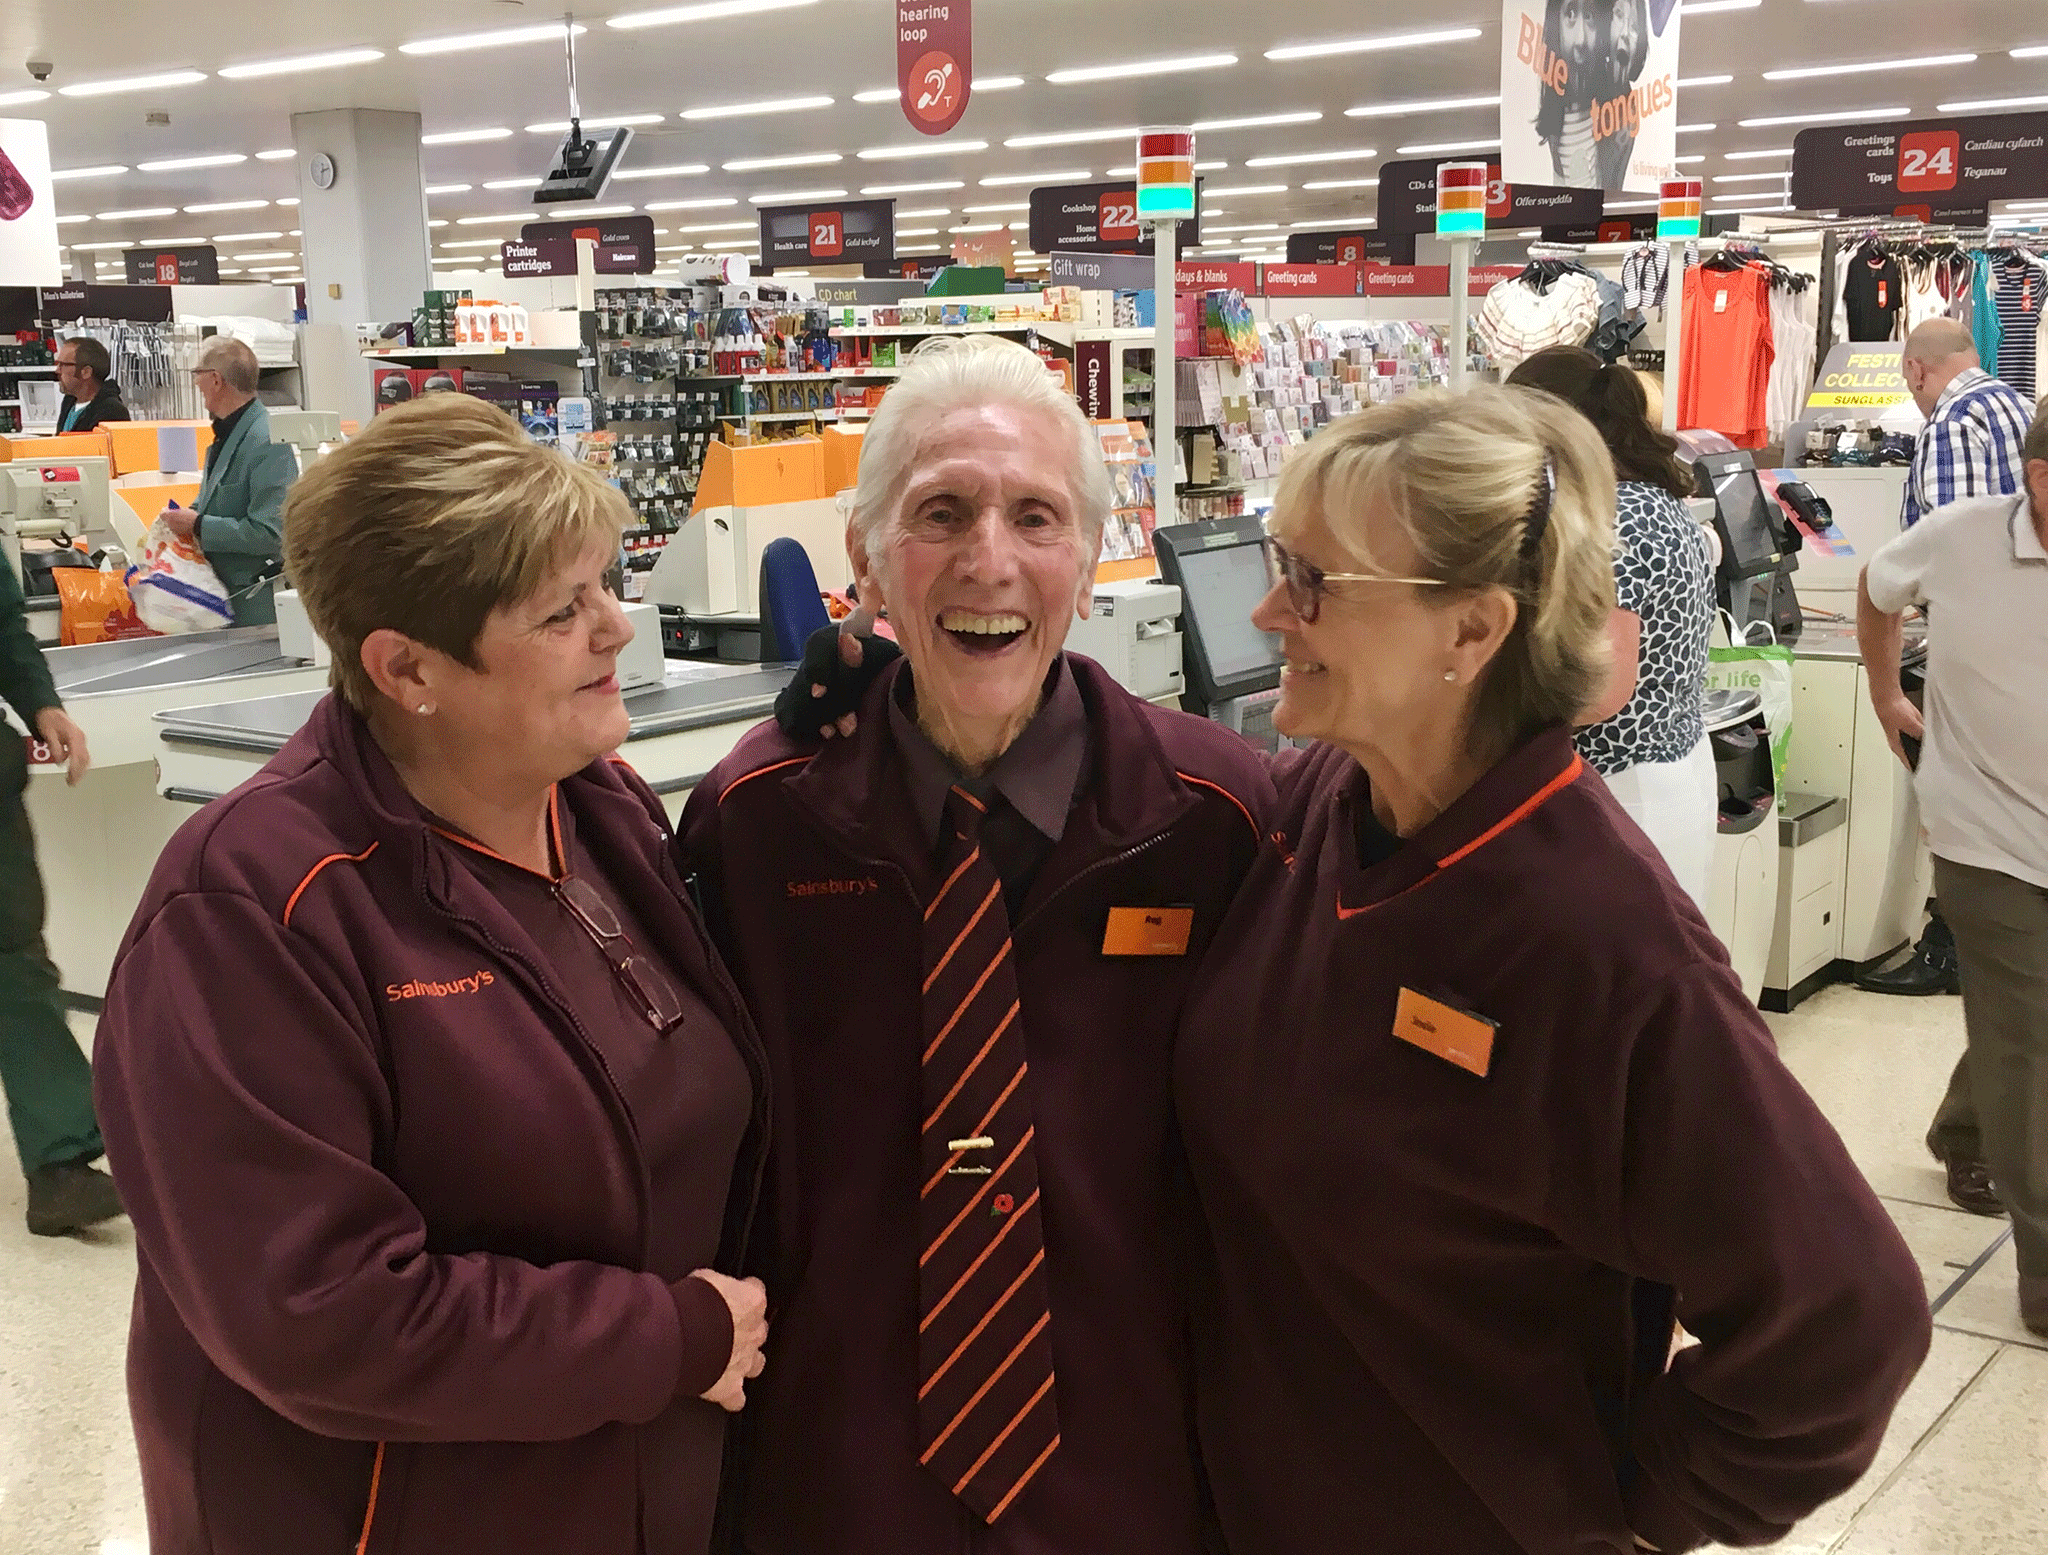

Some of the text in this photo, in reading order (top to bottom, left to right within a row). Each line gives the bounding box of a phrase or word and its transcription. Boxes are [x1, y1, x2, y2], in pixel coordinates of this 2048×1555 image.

[900, 4, 949, 22] hearing
[900, 27, 927, 43] loop
[1517, 12, 1568, 96] Blue
[1590, 73, 1672, 141] tongues
[1844, 134, 1896, 147] Greetings
[1964, 136, 2044, 151] Cardiau cyfarch
[1866, 146, 1895, 158] cards
[1902, 147, 1953, 177] 24
[1867, 173, 1893, 184] Toys
[1963, 166, 2007, 179] Teganau
[1408, 179, 1435, 190] CDs &
[1483, 180, 1506, 204] 3
[1515, 194, 1573, 207] Offer swyddfa
[1062, 203, 1097, 214] Cookshop
[1415, 203, 1437, 214] Stati
[1102, 205, 1137, 228] 22
[814, 224, 837, 246] 21
[1076, 224, 1097, 233] Home
[845, 237, 880, 248] Gofal iechyd
[1058, 233, 1097, 244] accessories
[1608, 231, 1621, 242] 7
[506, 245, 538, 257] Printer
[774, 243, 794, 251] Health
[1343, 246, 1357, 260] 8
[612, 253, 636, 261] Haircare
[160, 264, 176, 281] 18
[507, 259, 552, 273] cartridges
[1053, 258, 1101, 280] Gift wrap
[1175, 269, 1228, 286] days & blanks
[1267, 270, 1318, 286] Greeting cards
[1368, 272, 1414, 287] Greeting cards
[1467, 272, 1484, 284] dren's
[818, 288, 858, 301] CD chart
[1847, 353, 1902, 368] FESTI
[1727, 669, 1762, 688] life
[786, 878, 878, 897] Sainsbury's
[386, 969, 494, 1002] Sainsbury's
